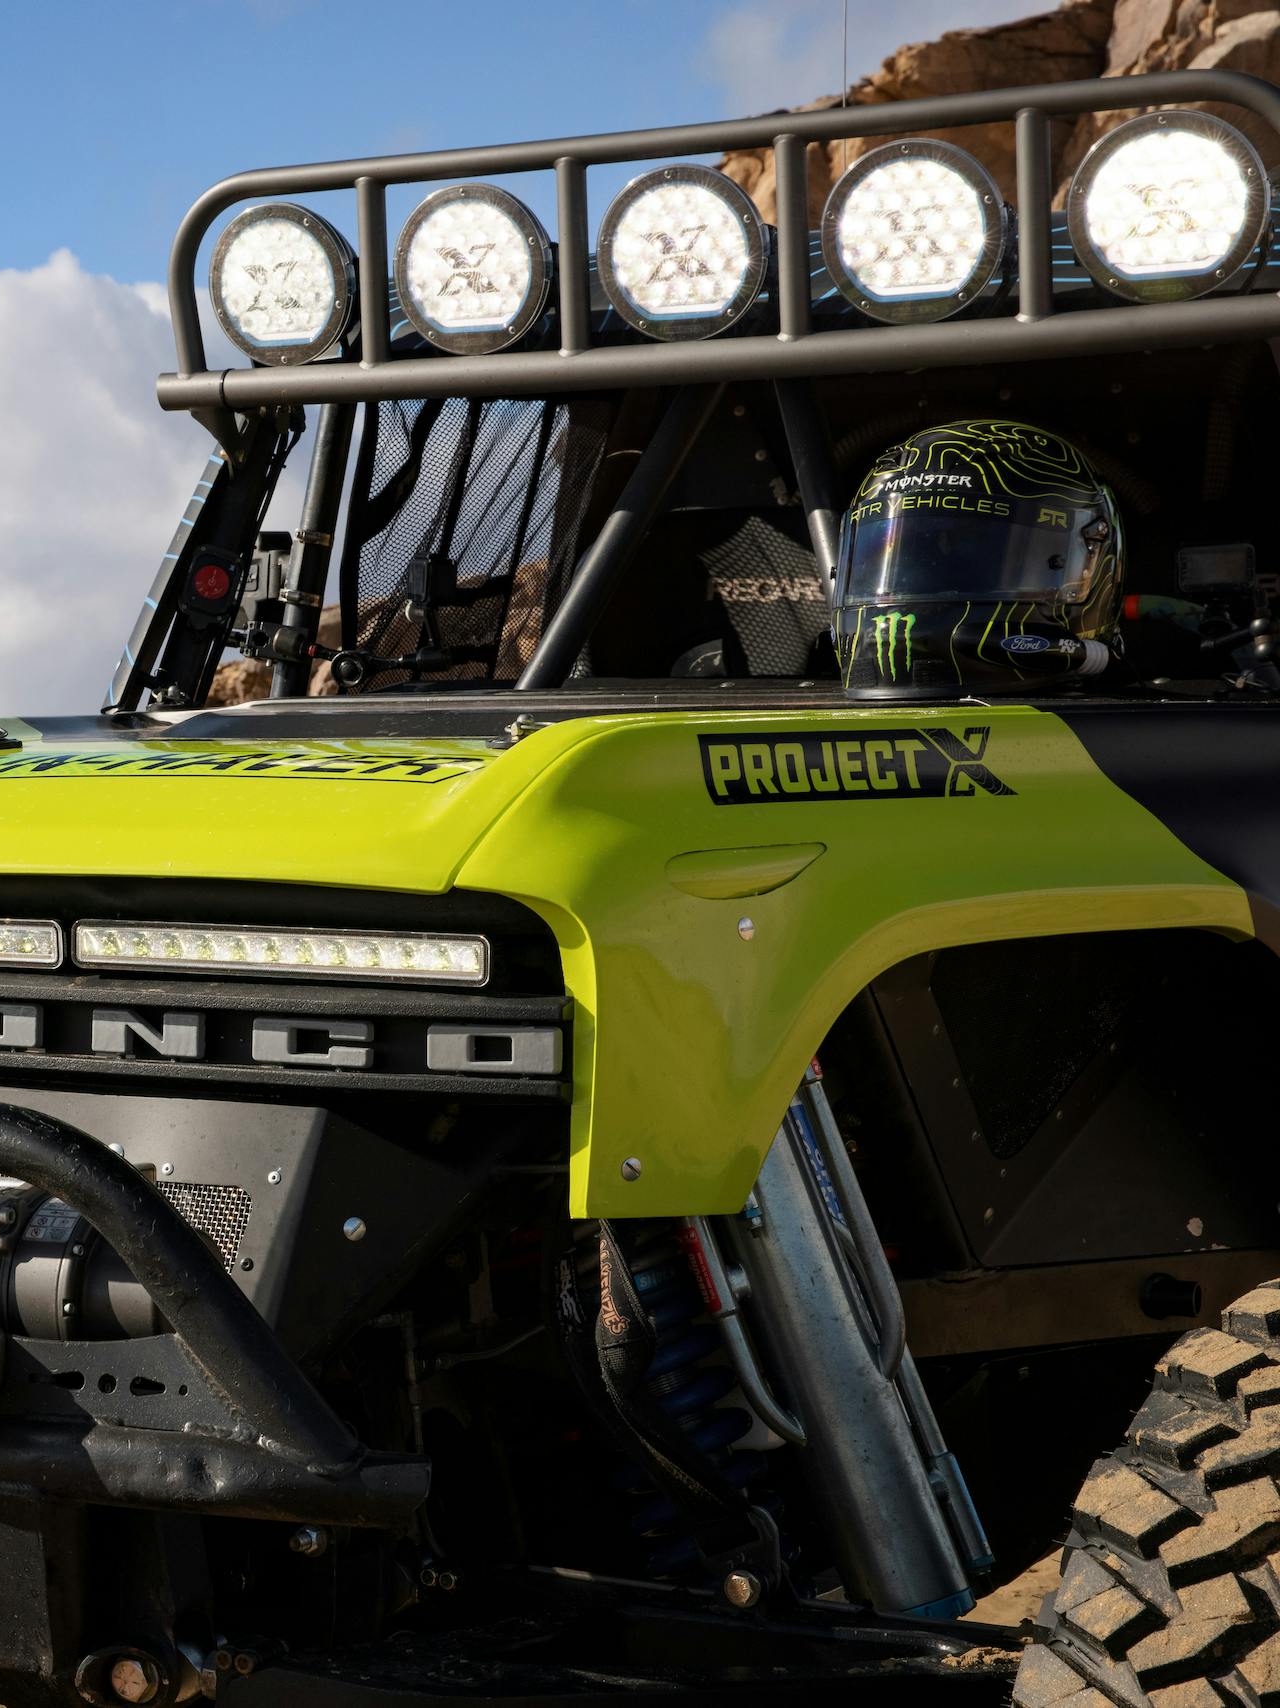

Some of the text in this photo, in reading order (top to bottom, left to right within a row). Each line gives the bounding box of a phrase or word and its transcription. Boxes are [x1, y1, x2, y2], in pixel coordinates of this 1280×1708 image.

[887, 495, 1010, 517] VEHICLES
[707, 577, 827, 602] RECAR
[707, 726, 1020, 797] PROJECT X
